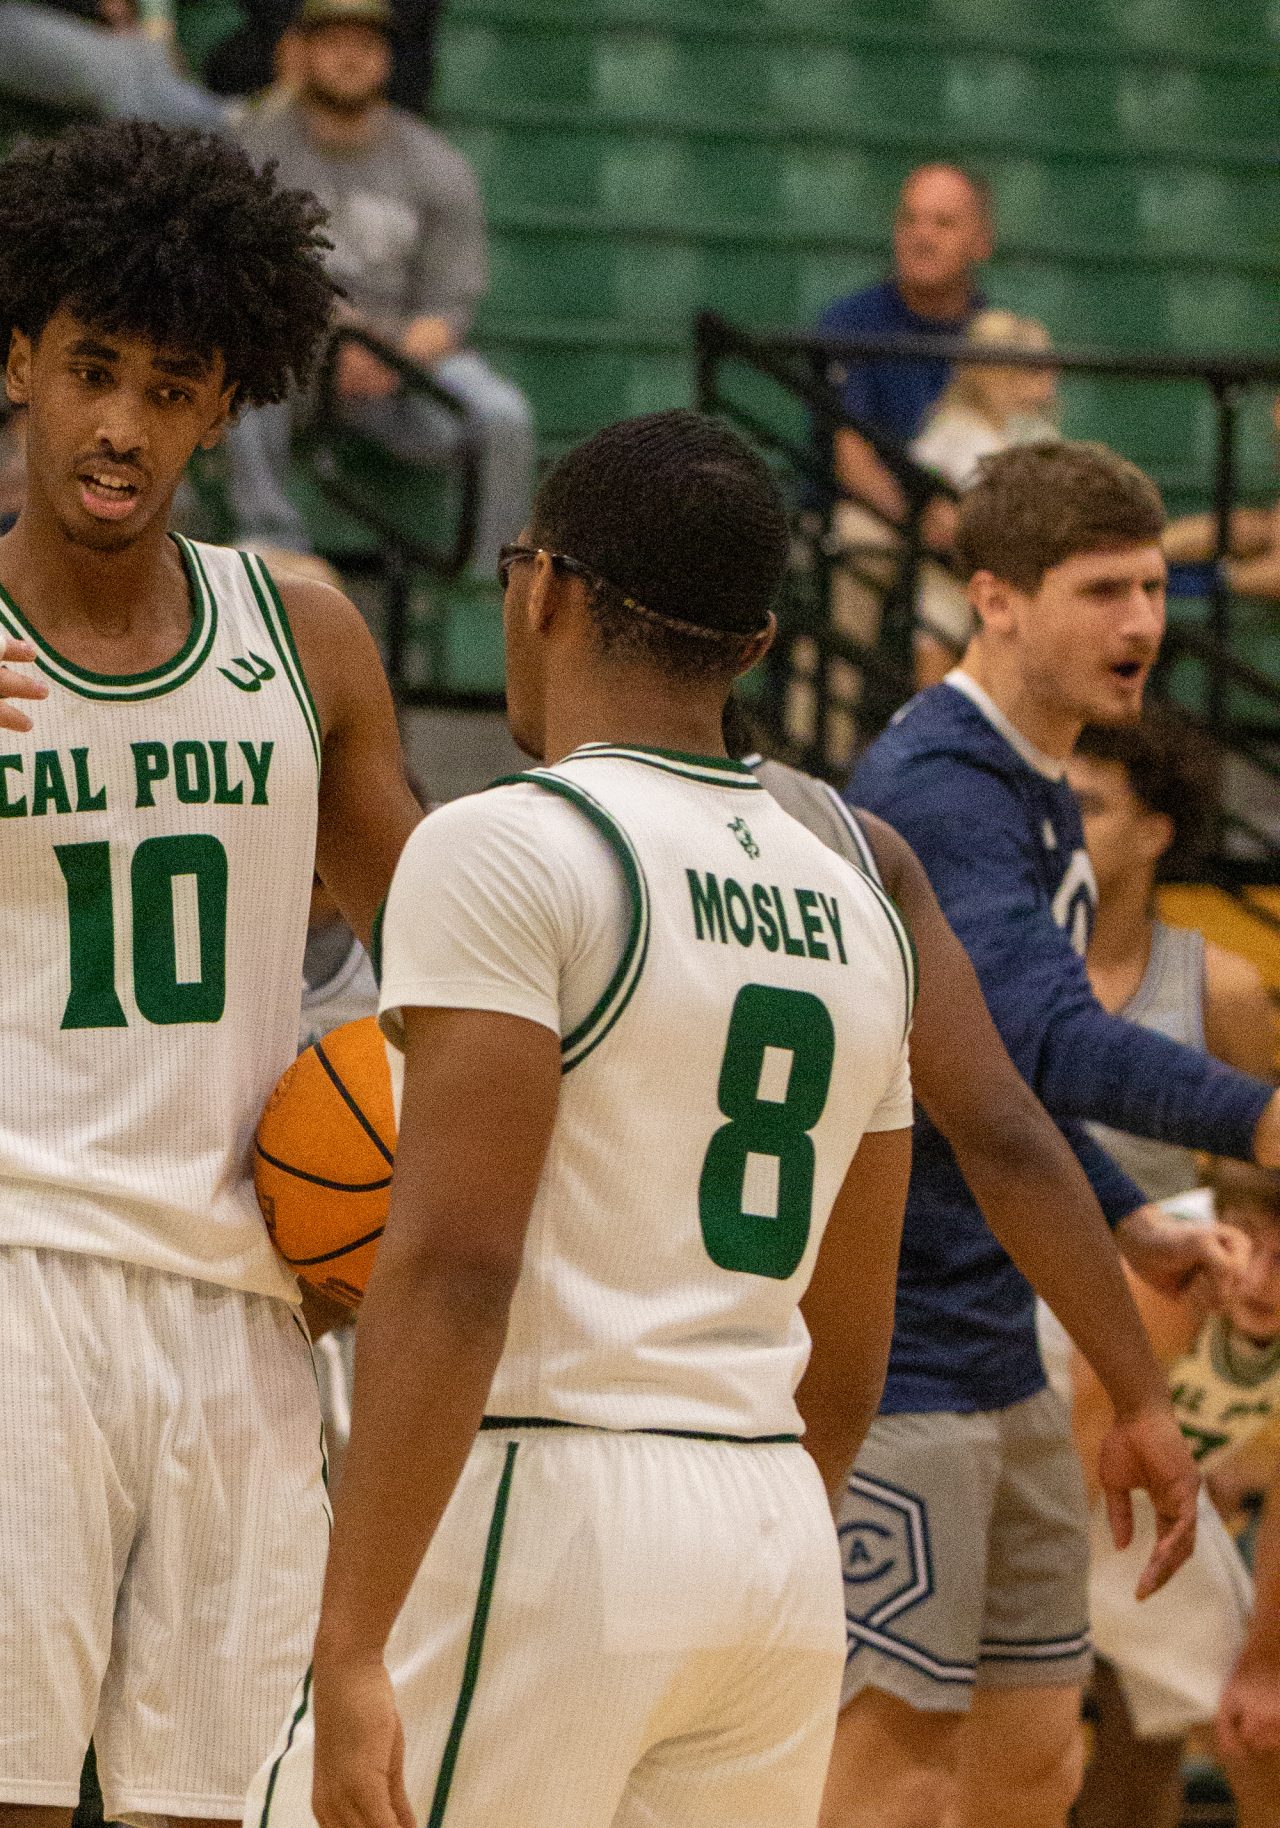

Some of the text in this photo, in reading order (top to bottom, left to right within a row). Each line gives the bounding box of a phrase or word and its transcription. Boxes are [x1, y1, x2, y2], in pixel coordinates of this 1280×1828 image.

[130, 740, 275, 807] POLY
[54, 833, 229, 1030] 10
[684, 868, 849, 966] MOSLEY
[698, 983, 836, 1280] 8
